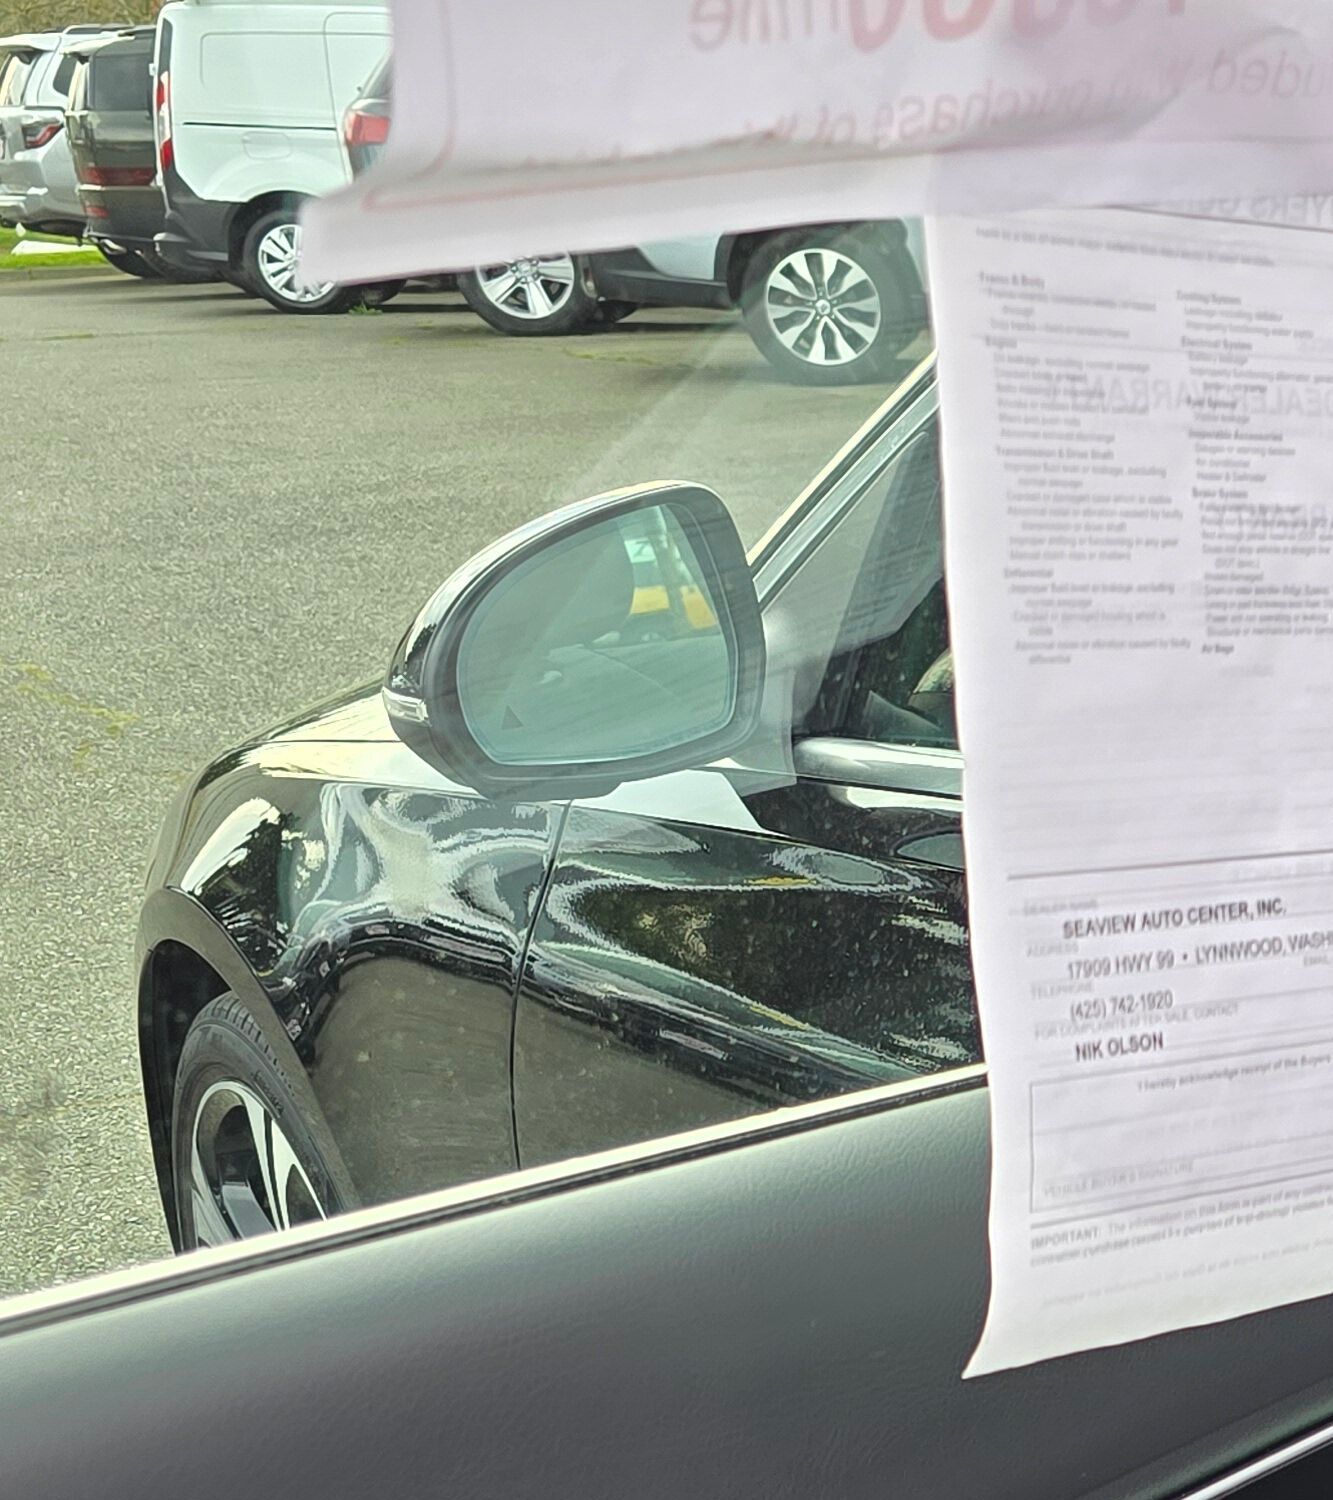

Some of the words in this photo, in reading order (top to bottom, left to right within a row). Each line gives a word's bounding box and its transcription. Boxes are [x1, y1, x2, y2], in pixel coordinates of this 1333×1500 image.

[1062, 913, 1136, 940] SEAVIEW
[1141, 906, 1184, 931] AUTO
[1187, 900, 1255, 925] CENTER,
[1257, 898, 1287, 917] INC.
[1067, 957, 1111, 981] 17909
[1115, 951, 1154, 976] HWY
[1156, 949, 1175, 971] 99
[1195, 936, 1287, 966] LYNNWOOD,
[1070, 998, 1107, 1024] (425)
[1111, 989, 1174, 1017] 742-1920
[1075, 1040, 1104, 1064] NIK
[1107, 1030, 1164, 1058] OLSON
